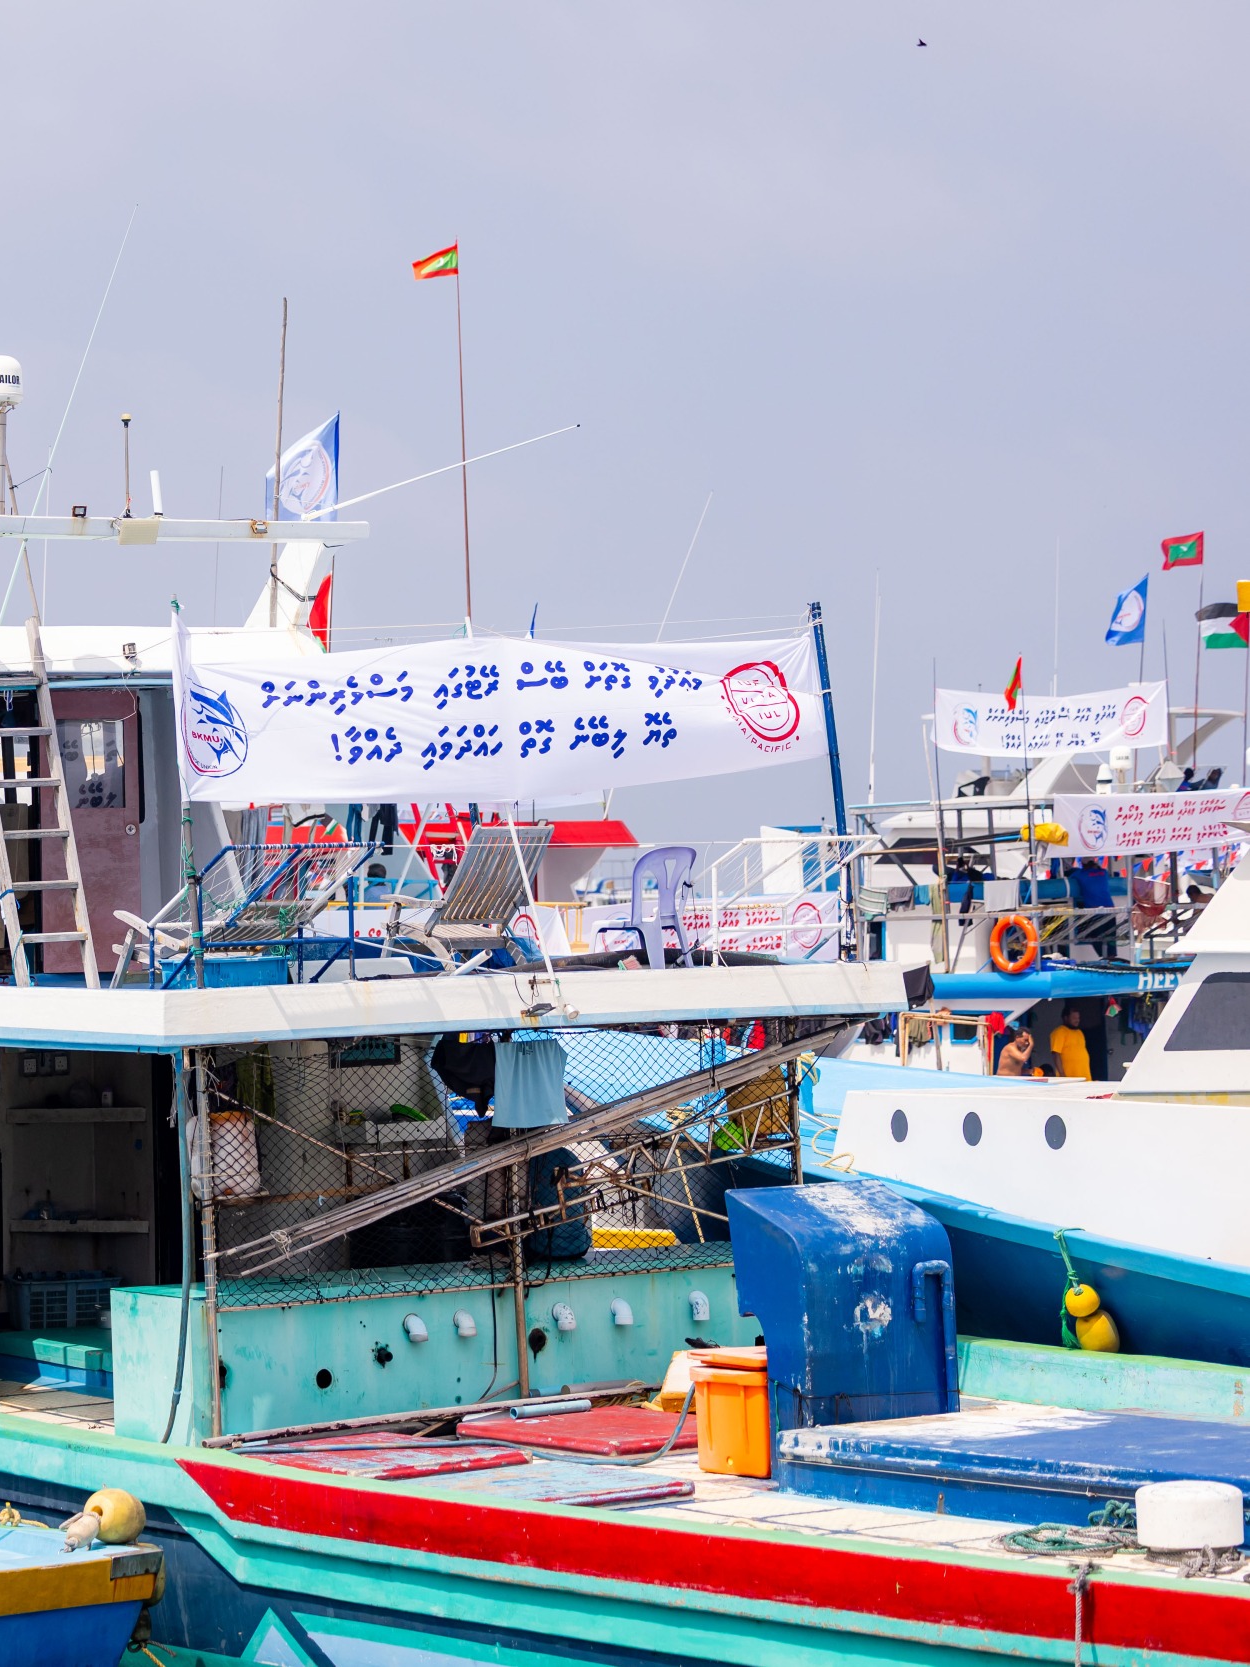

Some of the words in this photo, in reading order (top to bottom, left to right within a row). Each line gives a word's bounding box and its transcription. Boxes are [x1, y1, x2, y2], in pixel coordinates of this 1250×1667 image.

[516, 660, 568, 690] ބޭސް
[759, 711, 781, 719] IUL
[191, 731, 220, 743] BKMU
